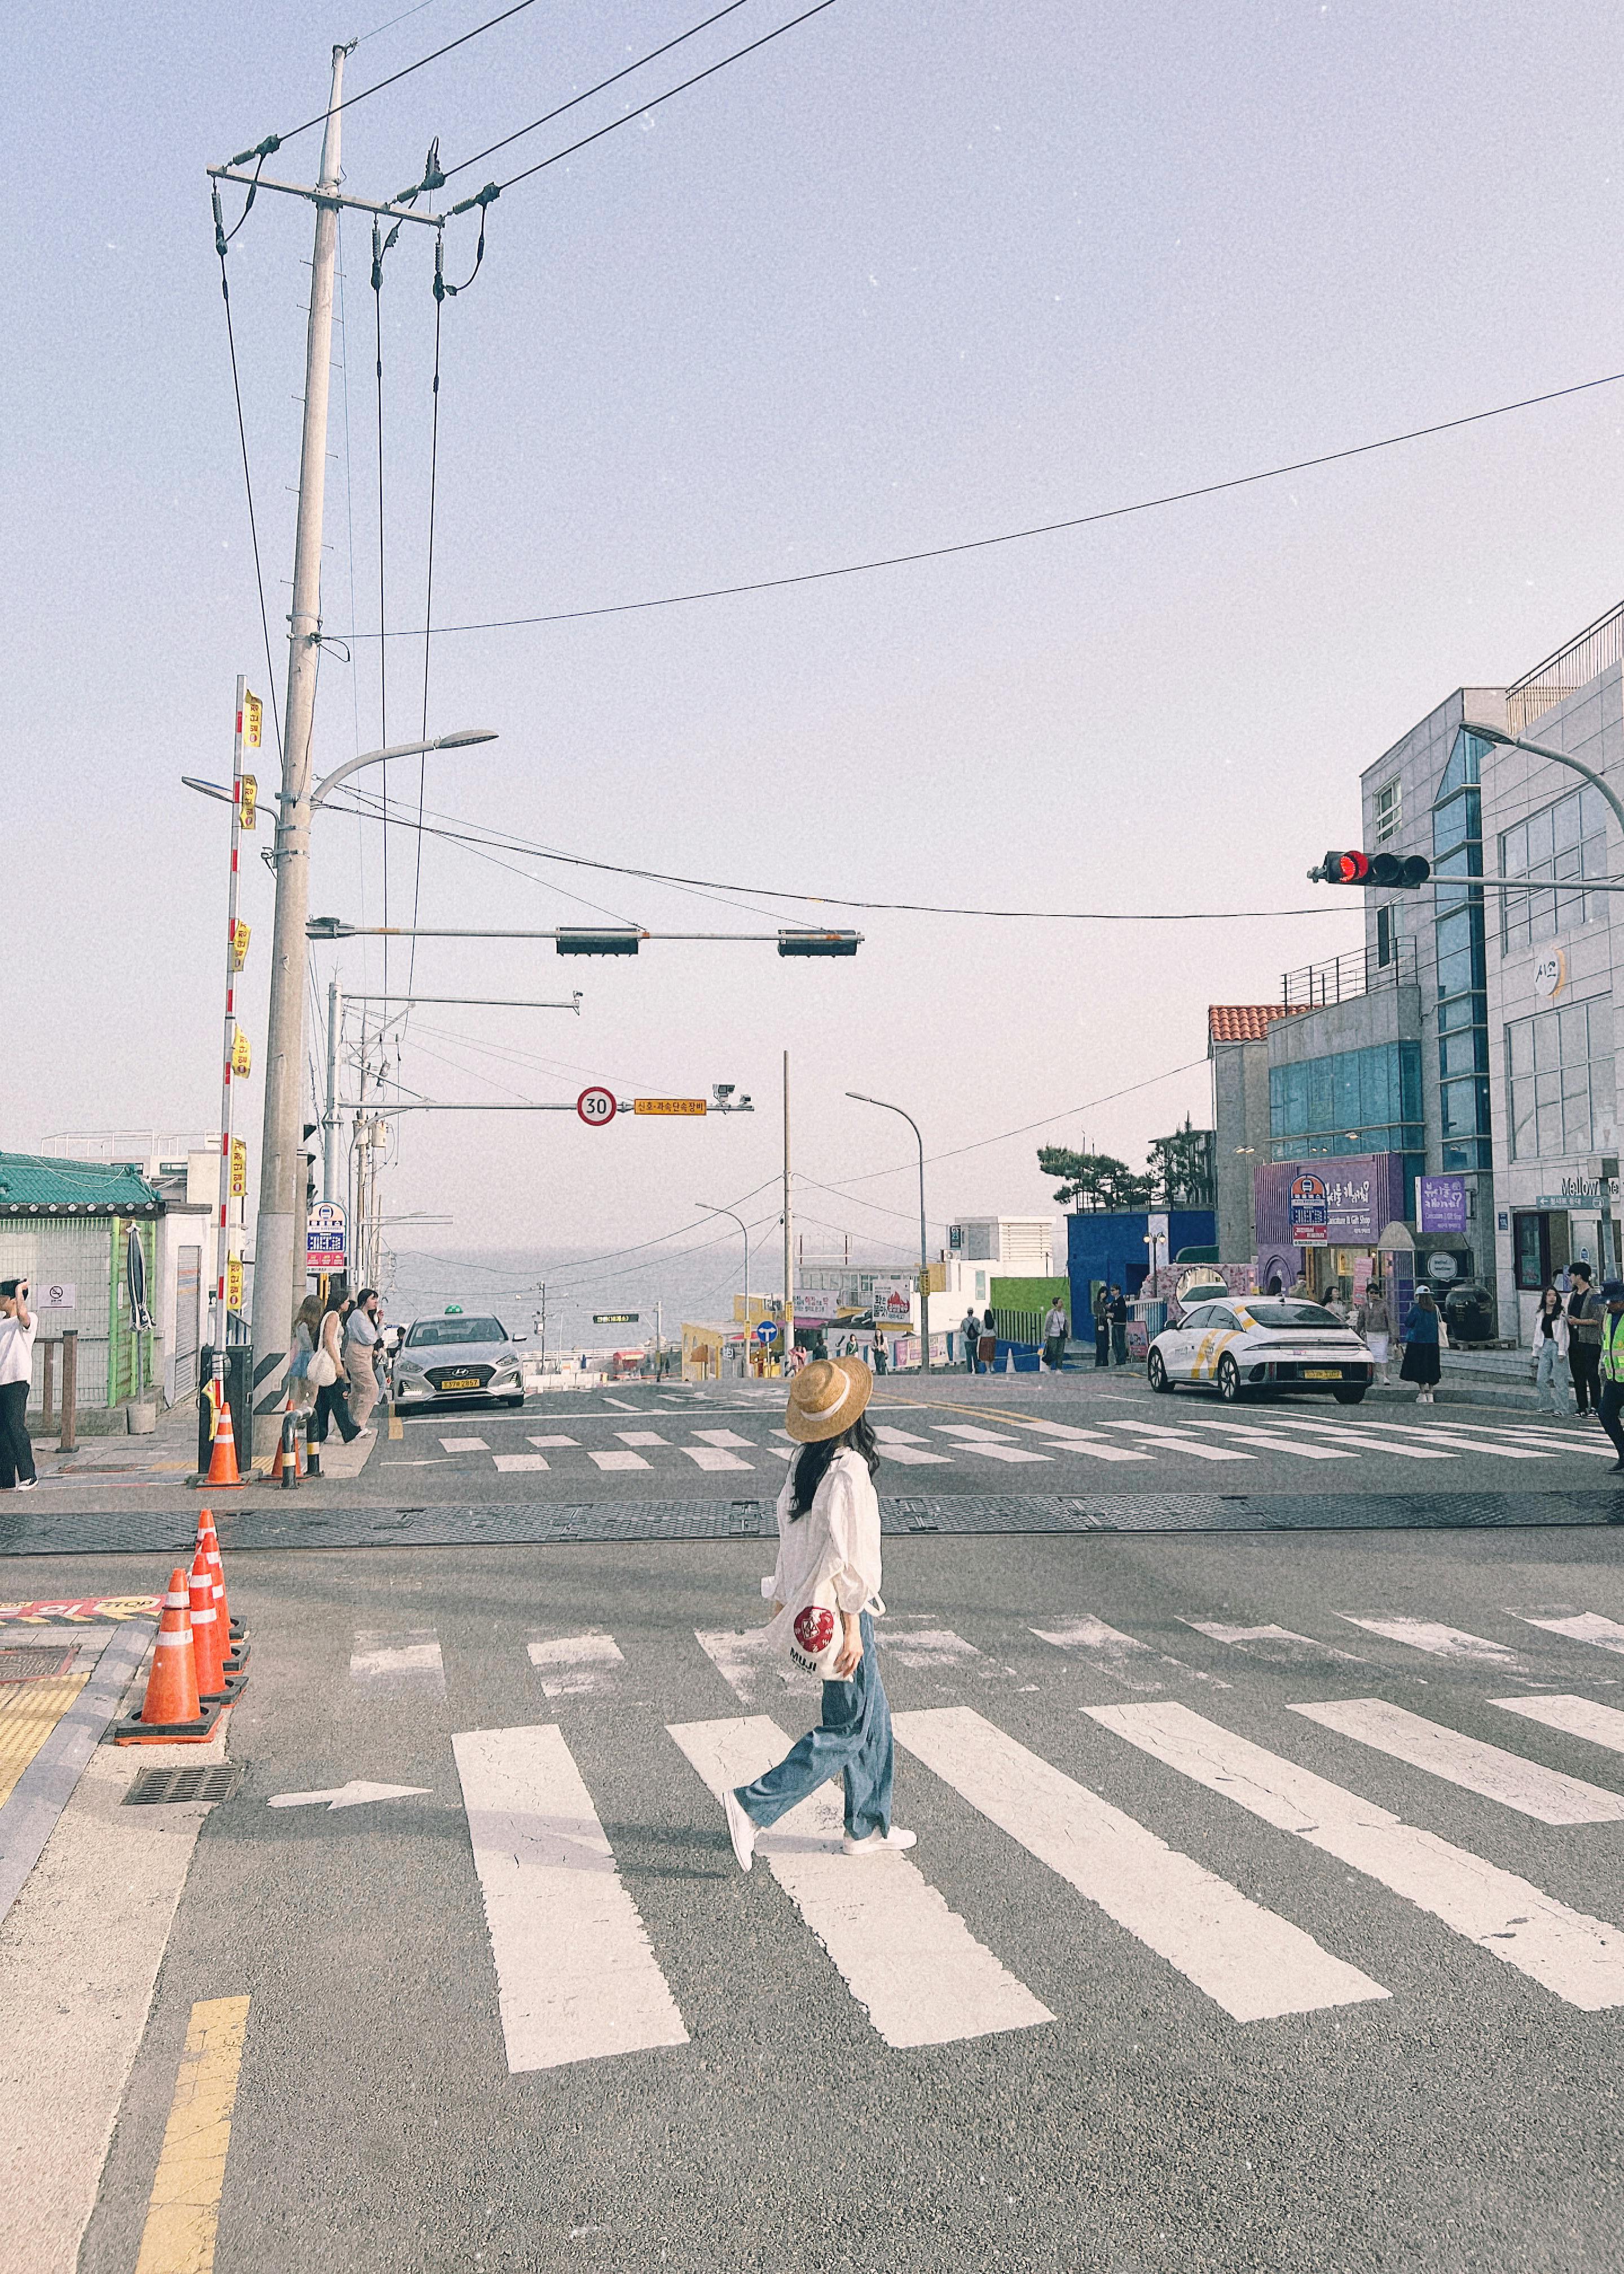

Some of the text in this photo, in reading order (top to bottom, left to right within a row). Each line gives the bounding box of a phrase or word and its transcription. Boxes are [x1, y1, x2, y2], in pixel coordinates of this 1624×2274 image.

[245, 778, 253, 815] 일단정지
[238, 1036, 248, 1063] 일단정
[587, 1098, 607, 1114] 30
[1561, 1176, 1599, 1196] Mellow
[790, 1647, 817, 1672] MUJI
